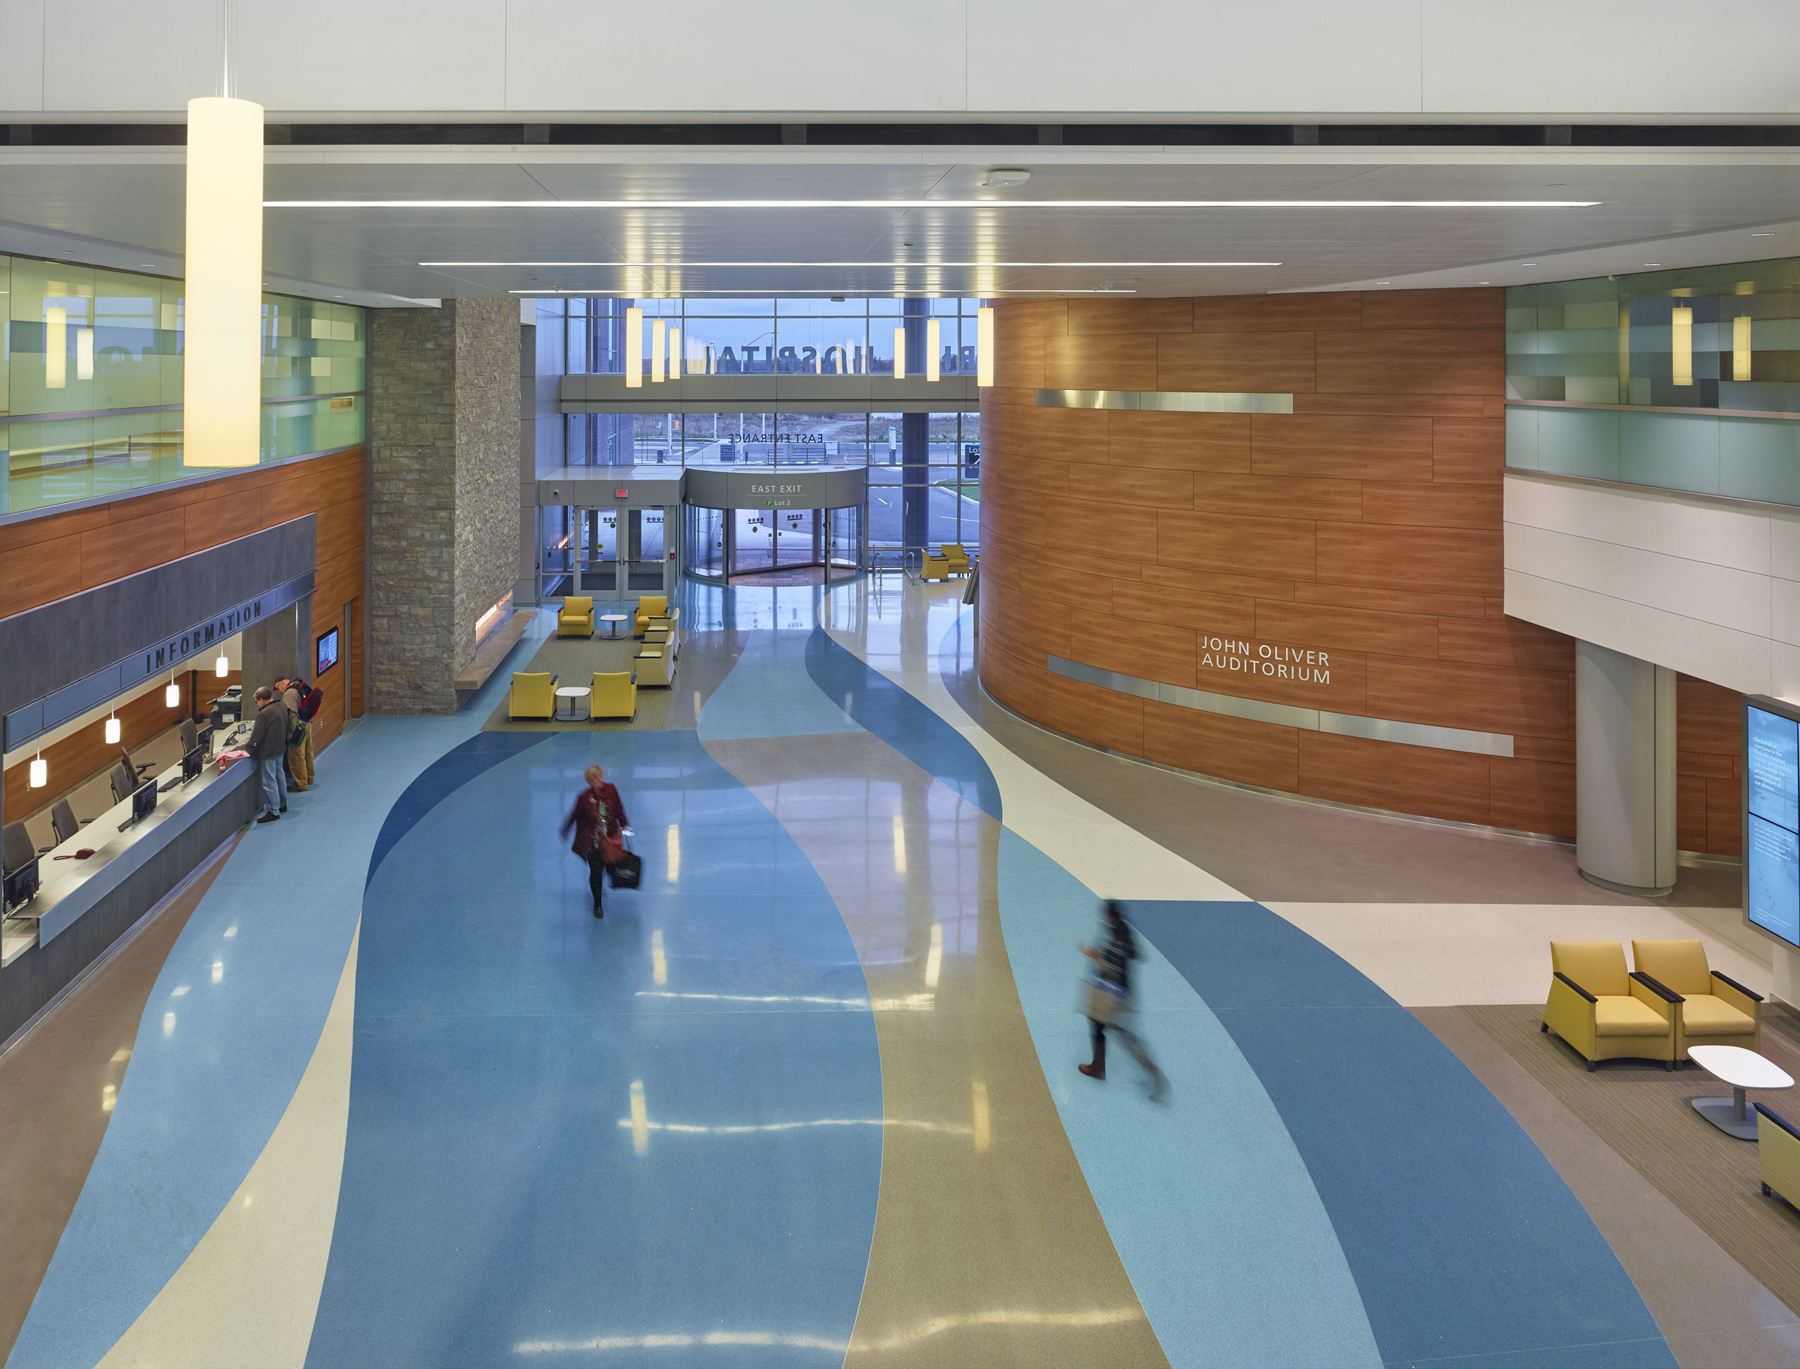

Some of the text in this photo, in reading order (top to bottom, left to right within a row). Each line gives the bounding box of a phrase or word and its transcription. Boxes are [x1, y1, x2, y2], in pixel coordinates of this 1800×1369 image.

[617, 489, 627, 497] EXIT
[752, 485, 802, 493] EAST EXIT
[146, 601, 261, 673] INFORMATION
[1201, 636, 1330, 667] JOHN OLIVER
[1201, 653, 1330, 685] AUDITORIUM
